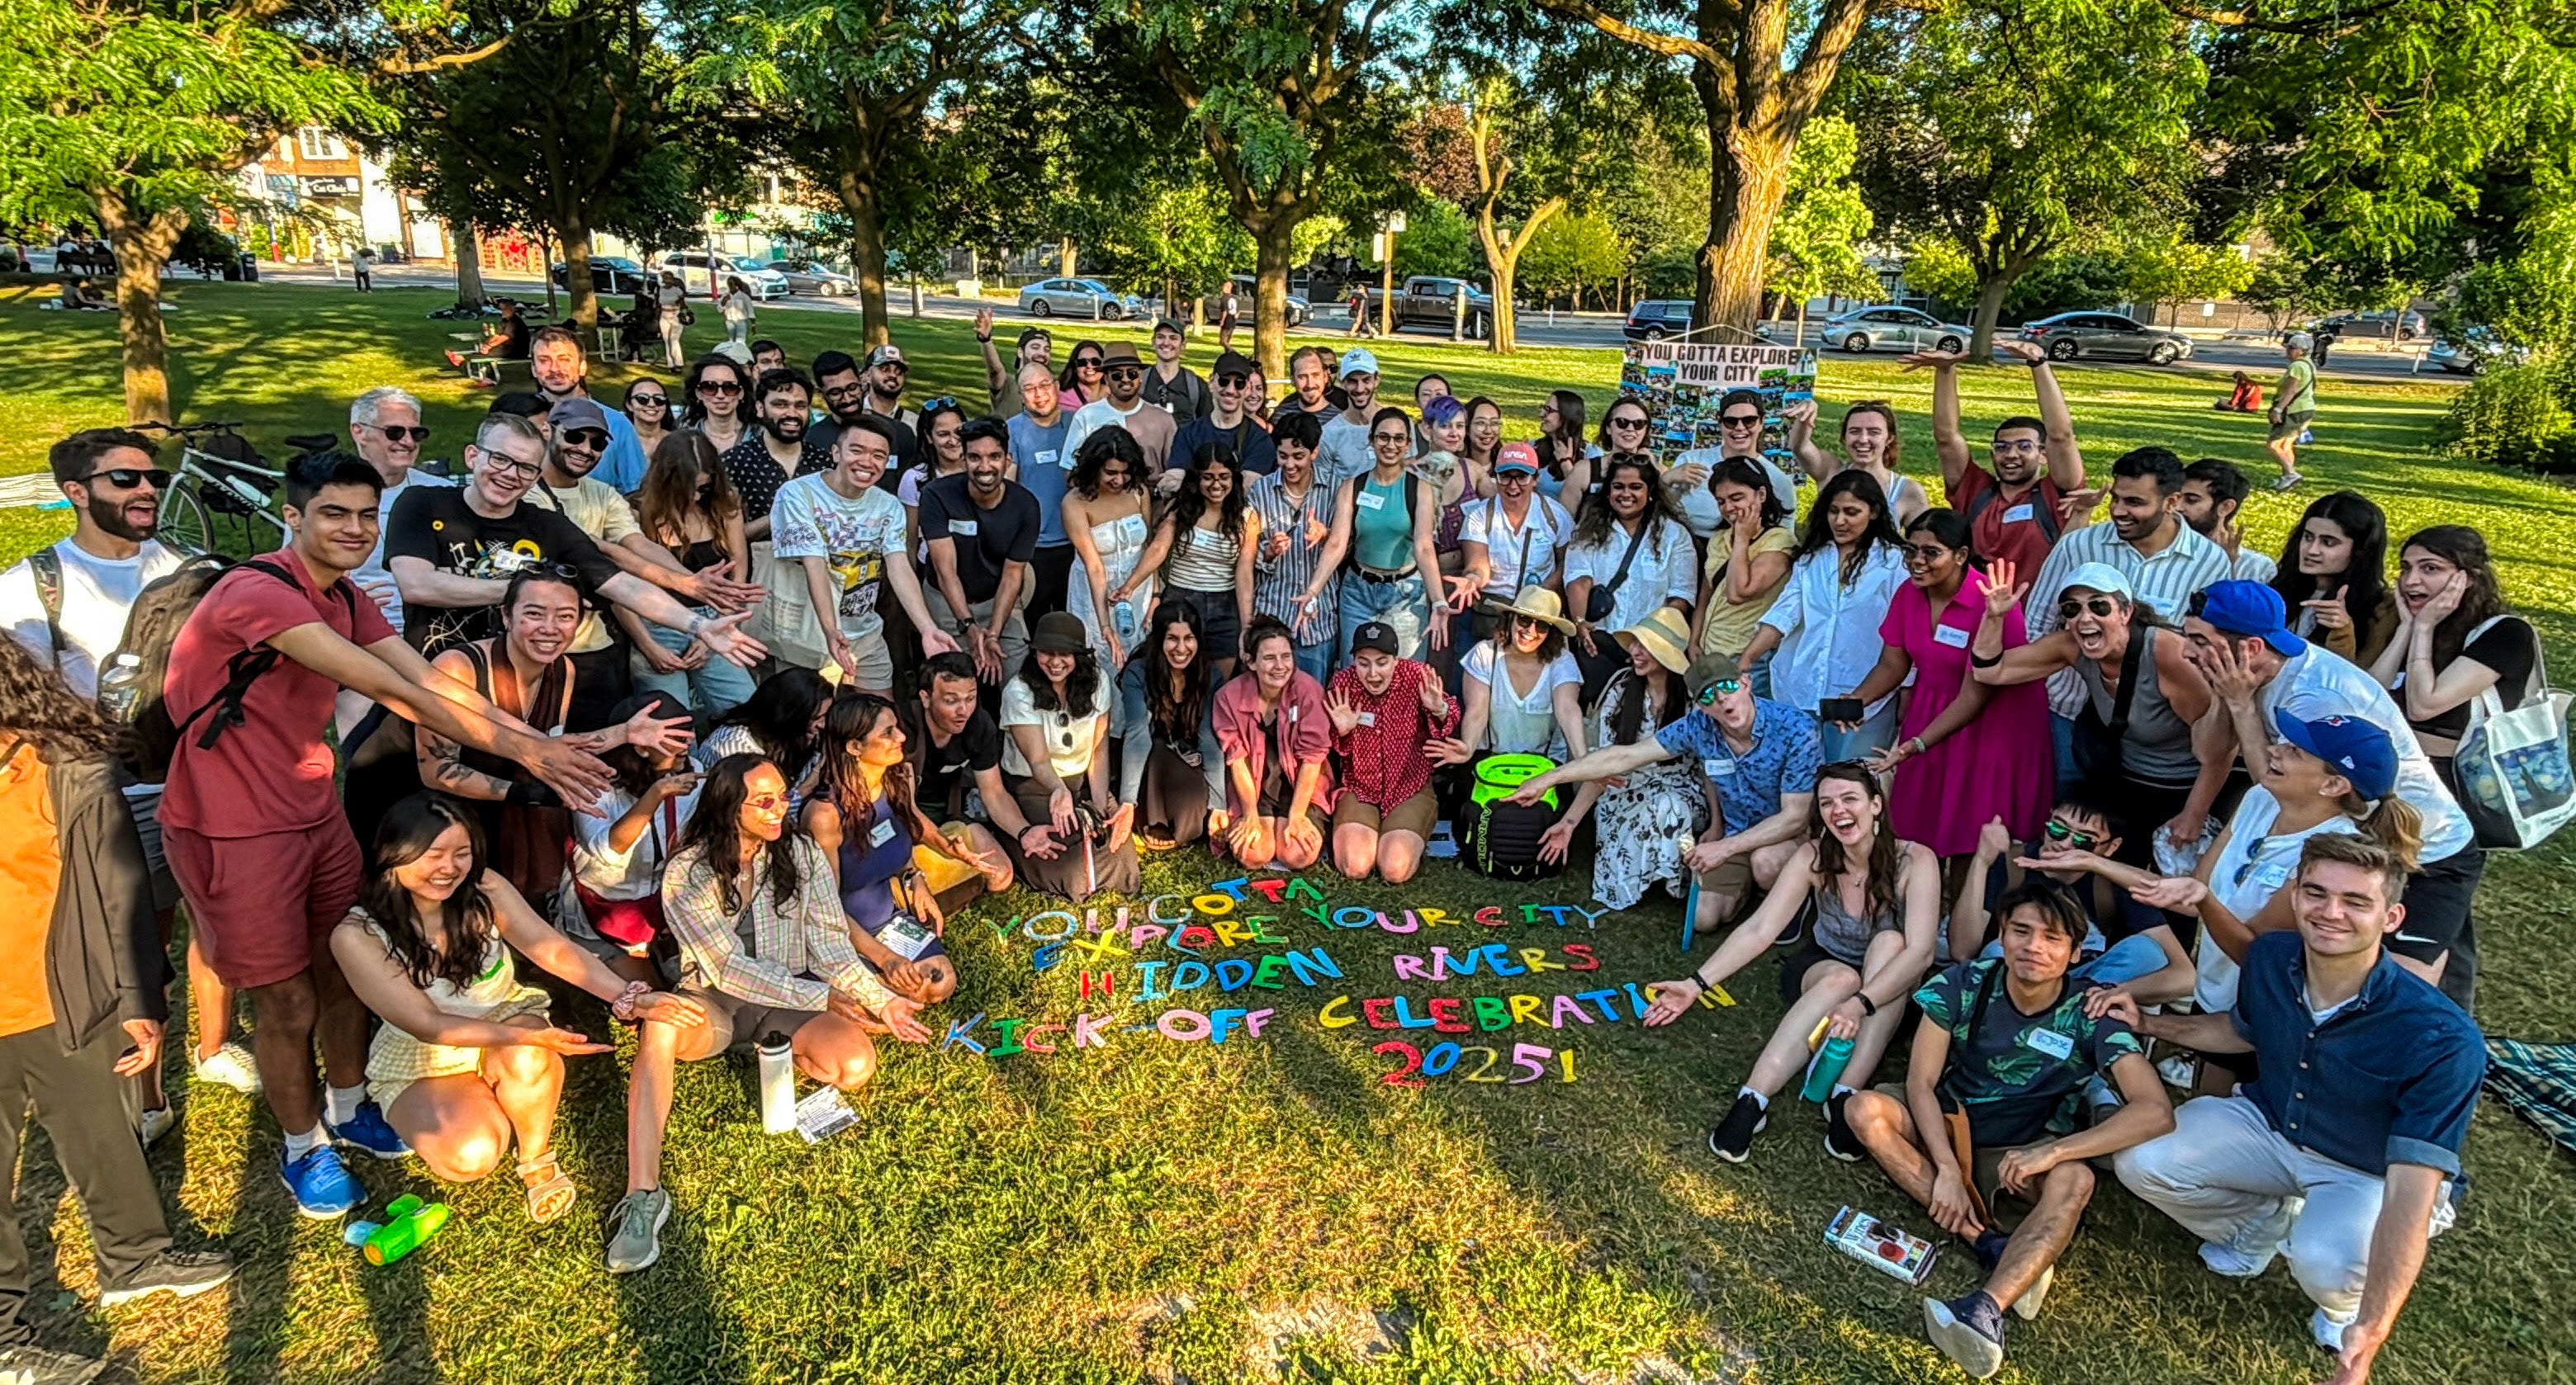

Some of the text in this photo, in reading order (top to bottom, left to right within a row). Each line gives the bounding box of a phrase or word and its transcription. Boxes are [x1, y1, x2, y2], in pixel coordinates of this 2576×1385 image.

[1645, 343, 1797, 366] YOU GOTTA EXPLORE
[1681, 363, 1759, 383] YOUR CITY
[1503, 451, 1527, 461] NASA
[981, 907, 1129, 944] YOU
[1148, 878, 1323, 924] GOTTA
[1034, 905, 1610, 971] EXPLORE YOUR CITY
[1078, 943, 1600, 1004] HIDDEN RIVERS
[940, 1008, 1275, 1058] KICK-OFF
[1371, 1041, 1579, 1088] 2025!
[1845, 1217, 1871, 1241] Wines
